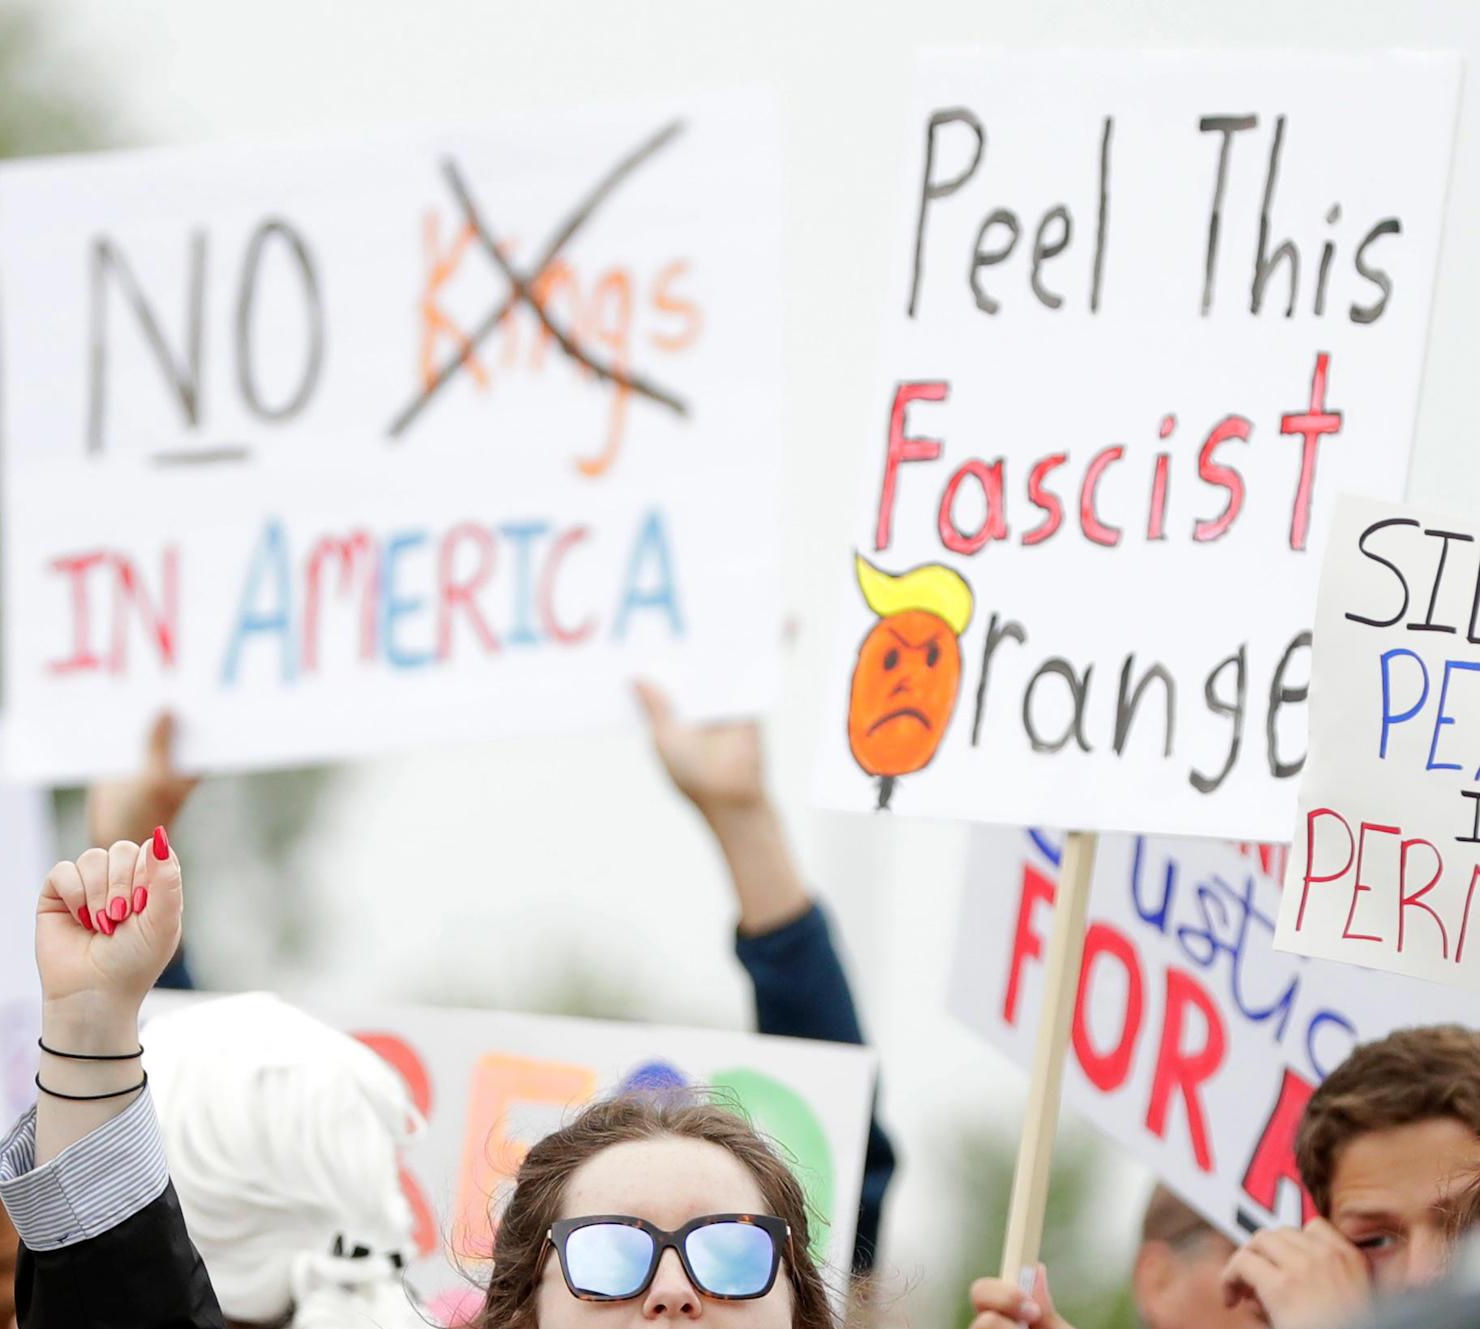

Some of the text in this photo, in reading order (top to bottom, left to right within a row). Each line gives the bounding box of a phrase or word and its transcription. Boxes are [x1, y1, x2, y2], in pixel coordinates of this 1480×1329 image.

[907, 105, 1404, 324] Peel This
[86, 207, 705, 478] NO Kings
[875, 351, 1343, 556] Fascist
[46, 502, 686, 689] IN AMERICA
[1003, 861, 1231, 1174] FOR
